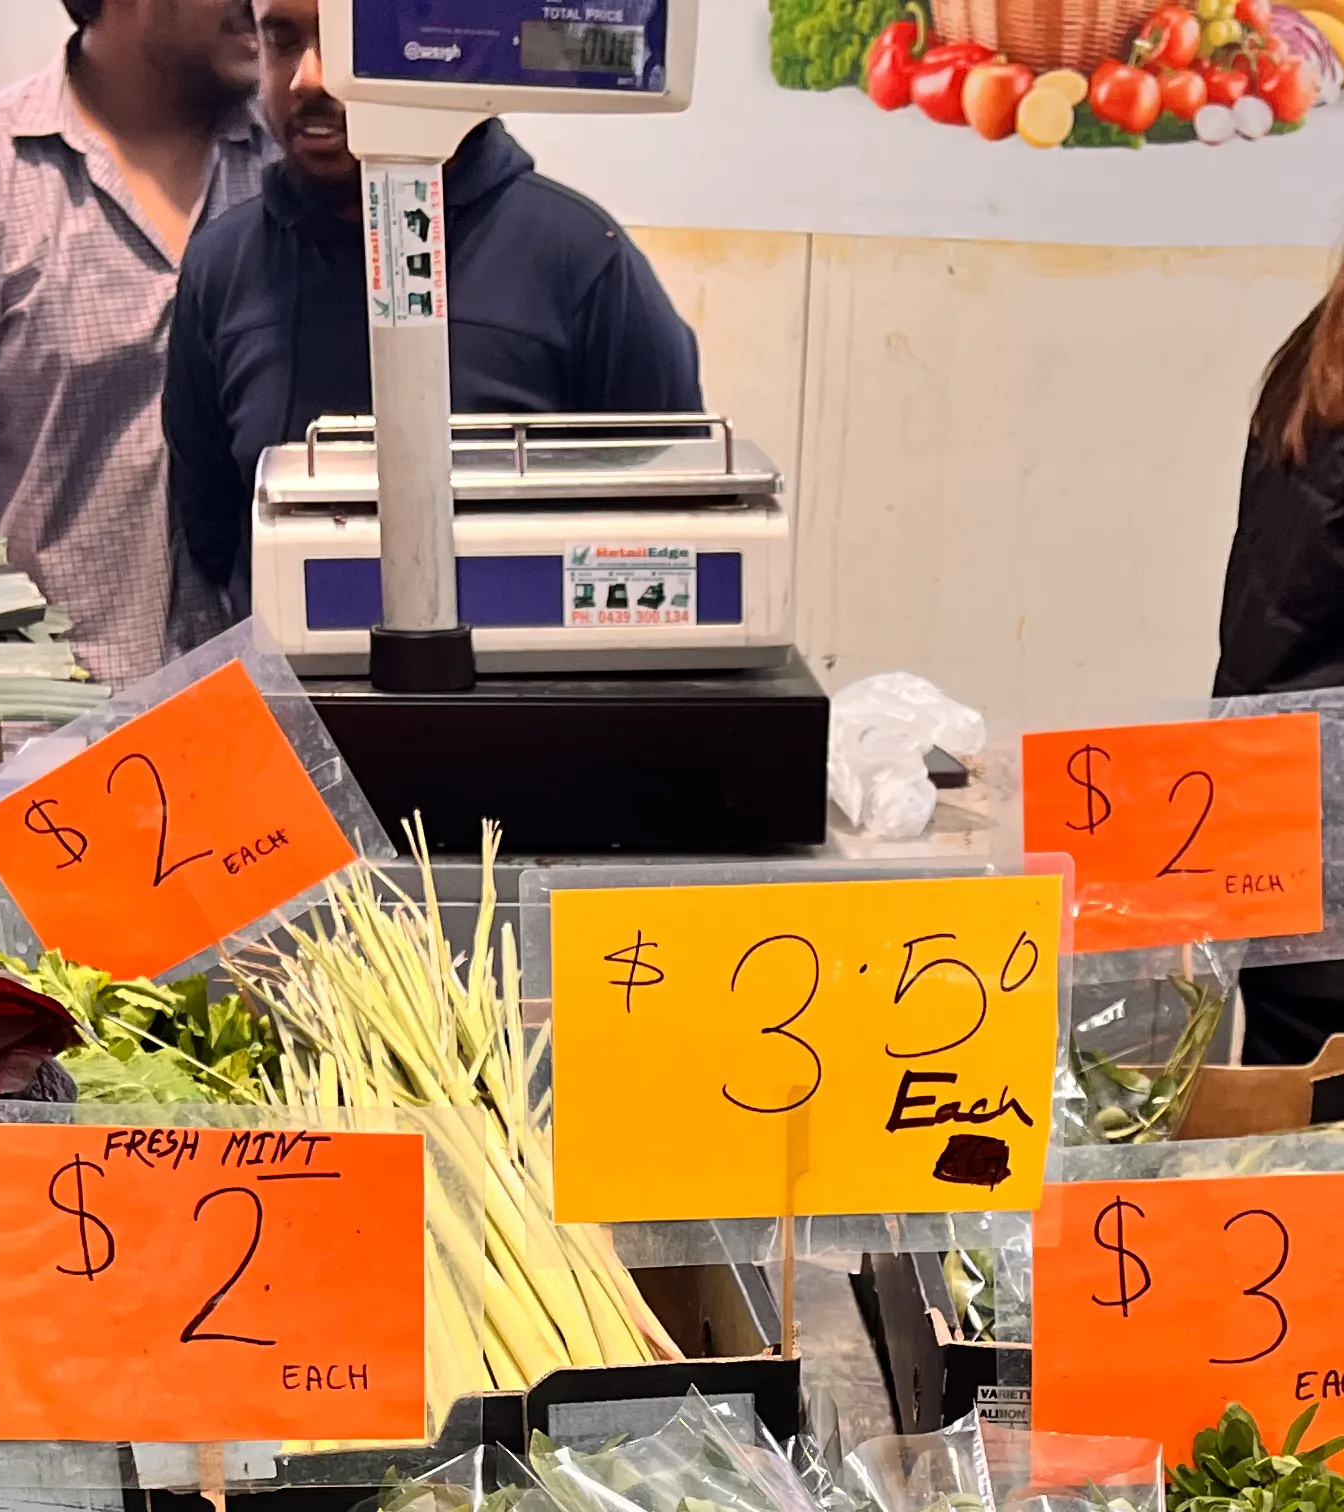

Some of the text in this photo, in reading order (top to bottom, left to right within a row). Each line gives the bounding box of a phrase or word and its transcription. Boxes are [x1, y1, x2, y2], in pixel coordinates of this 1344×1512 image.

[542, 7, 580, 20] TOTAL
[597, 548, 689, 560] RetailEdge
[598, 611, 631, 624] 0439
[636, 611, 660, 624] 300
[665, 611, 690, 624] 134
[222, 829, 290, 875] EACH
[1225, 874, 1285, 894] EACH
[885, 1069, 1034, 1133] Each
[103, 1130, 332, 1170] FRESH MINT
[282, 1364, 368, 1391] EACH
